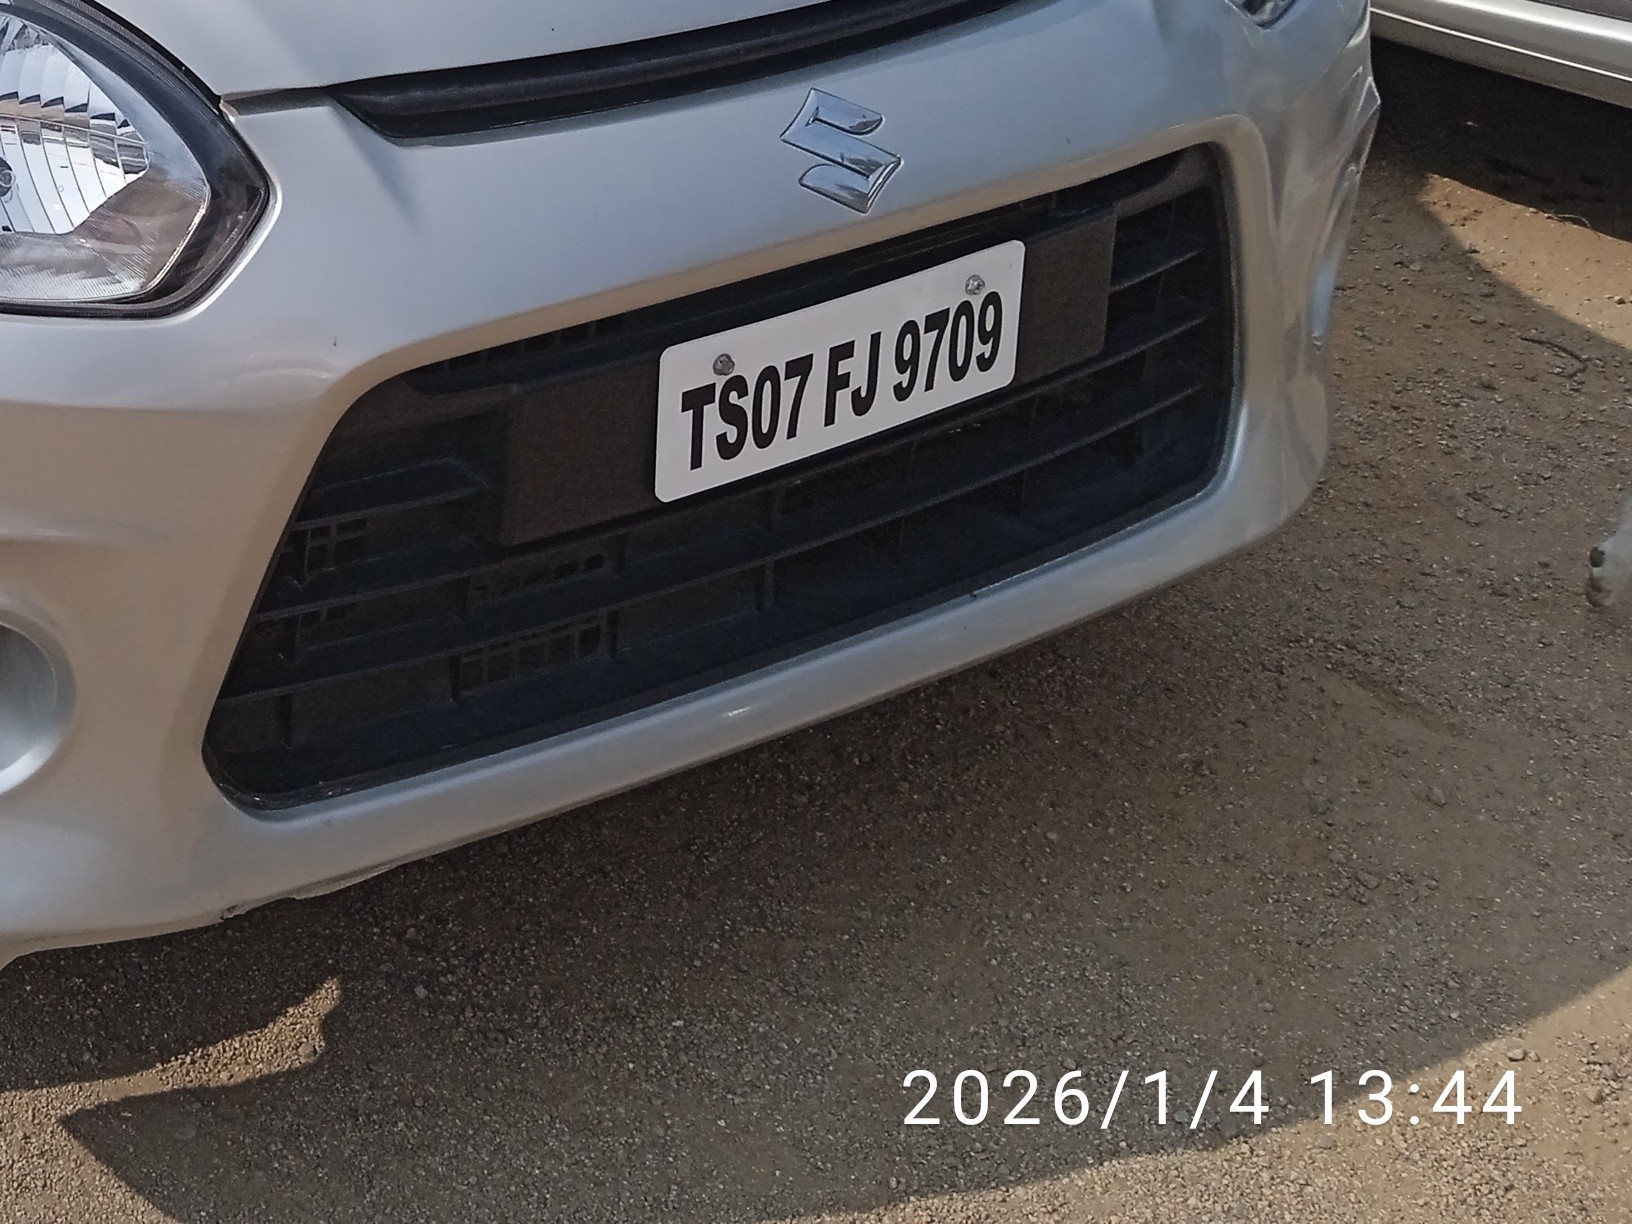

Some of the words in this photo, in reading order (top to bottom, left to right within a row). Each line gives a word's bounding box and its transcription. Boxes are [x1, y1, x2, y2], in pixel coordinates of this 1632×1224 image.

[681, 352, 815, 472] TS07
[823, 330, 883, 428] FJ
[891, 290, 1003, 403] 9709
